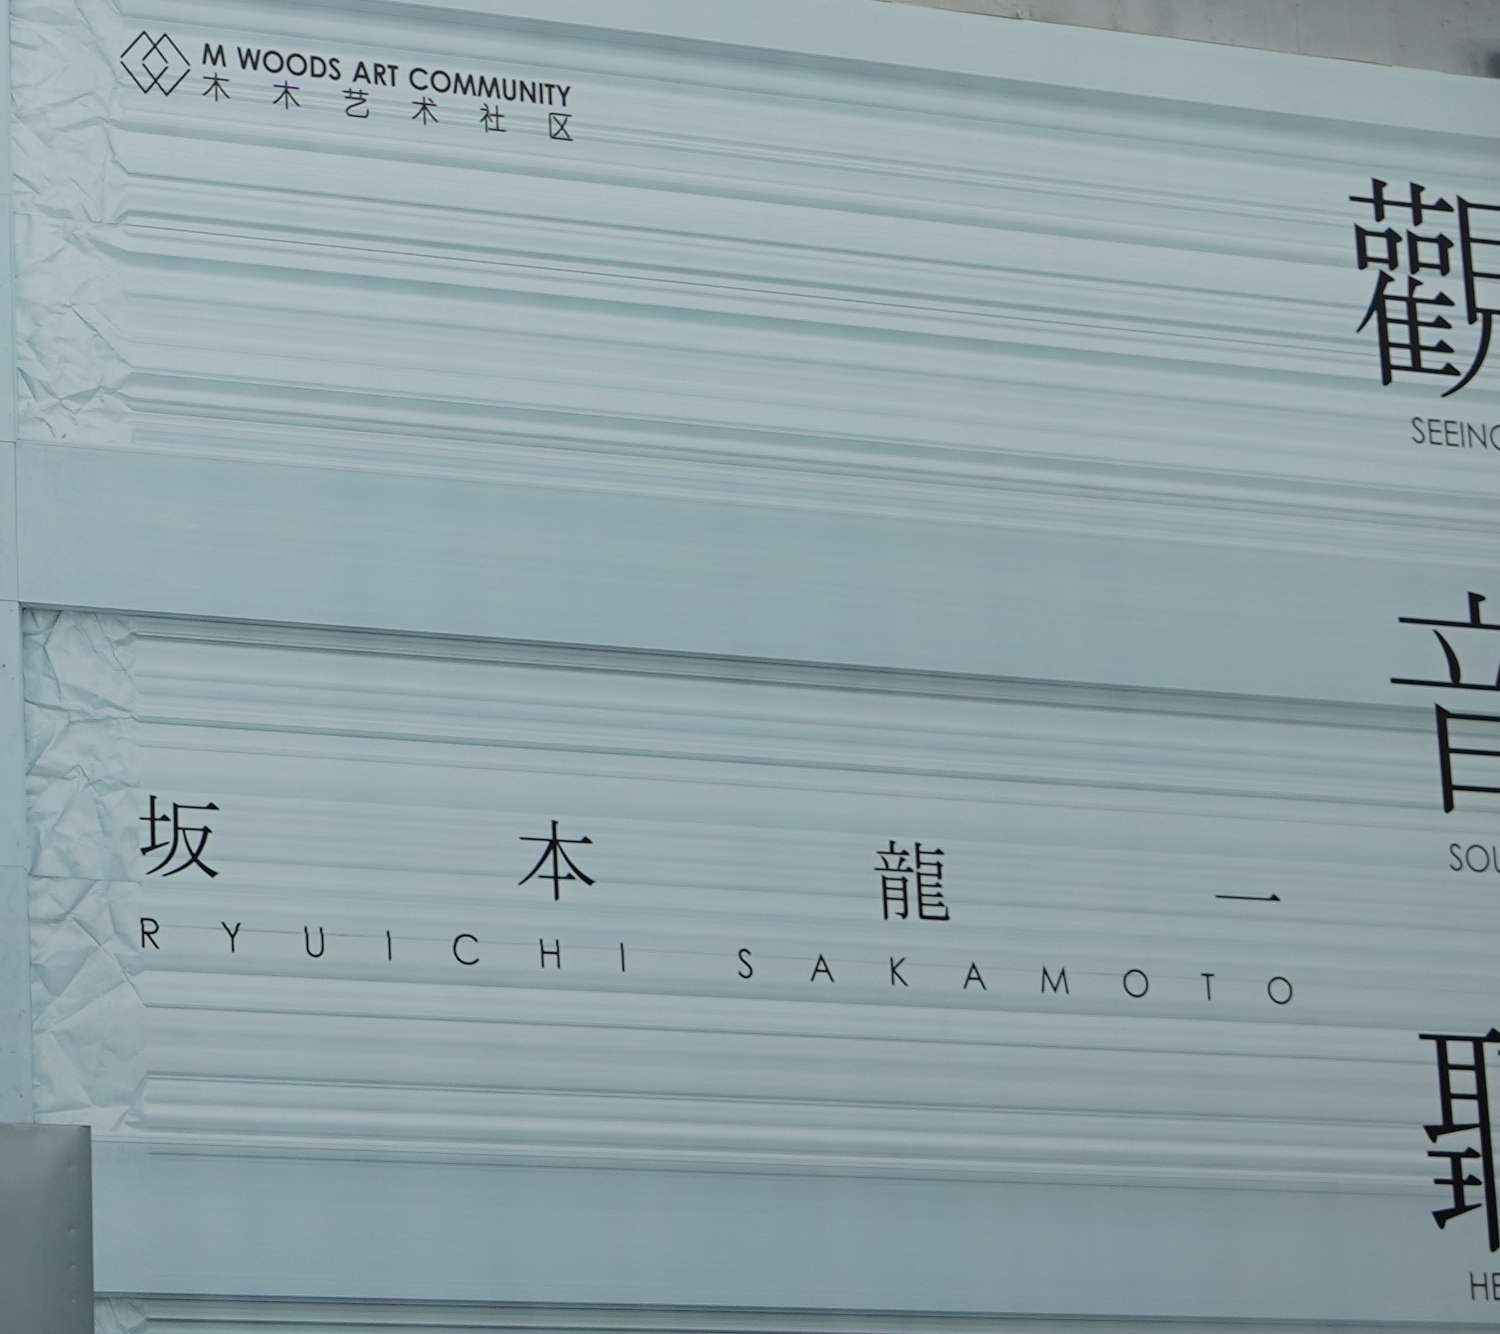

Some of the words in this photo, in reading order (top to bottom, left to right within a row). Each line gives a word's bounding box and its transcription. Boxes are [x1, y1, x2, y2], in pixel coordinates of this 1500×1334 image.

[202, 42, 227, 67] M
[236, 46, 341, 81] WOODS
[352, 60, 400, 88] ART
[408, 67, 572, 108] COMMUNITY
[202, 72, 574, 142] 木木艺术社区
[139, 917, 626, 973] RYUICHI
[738, 948, 1293, 1005] SAKAMOTO
